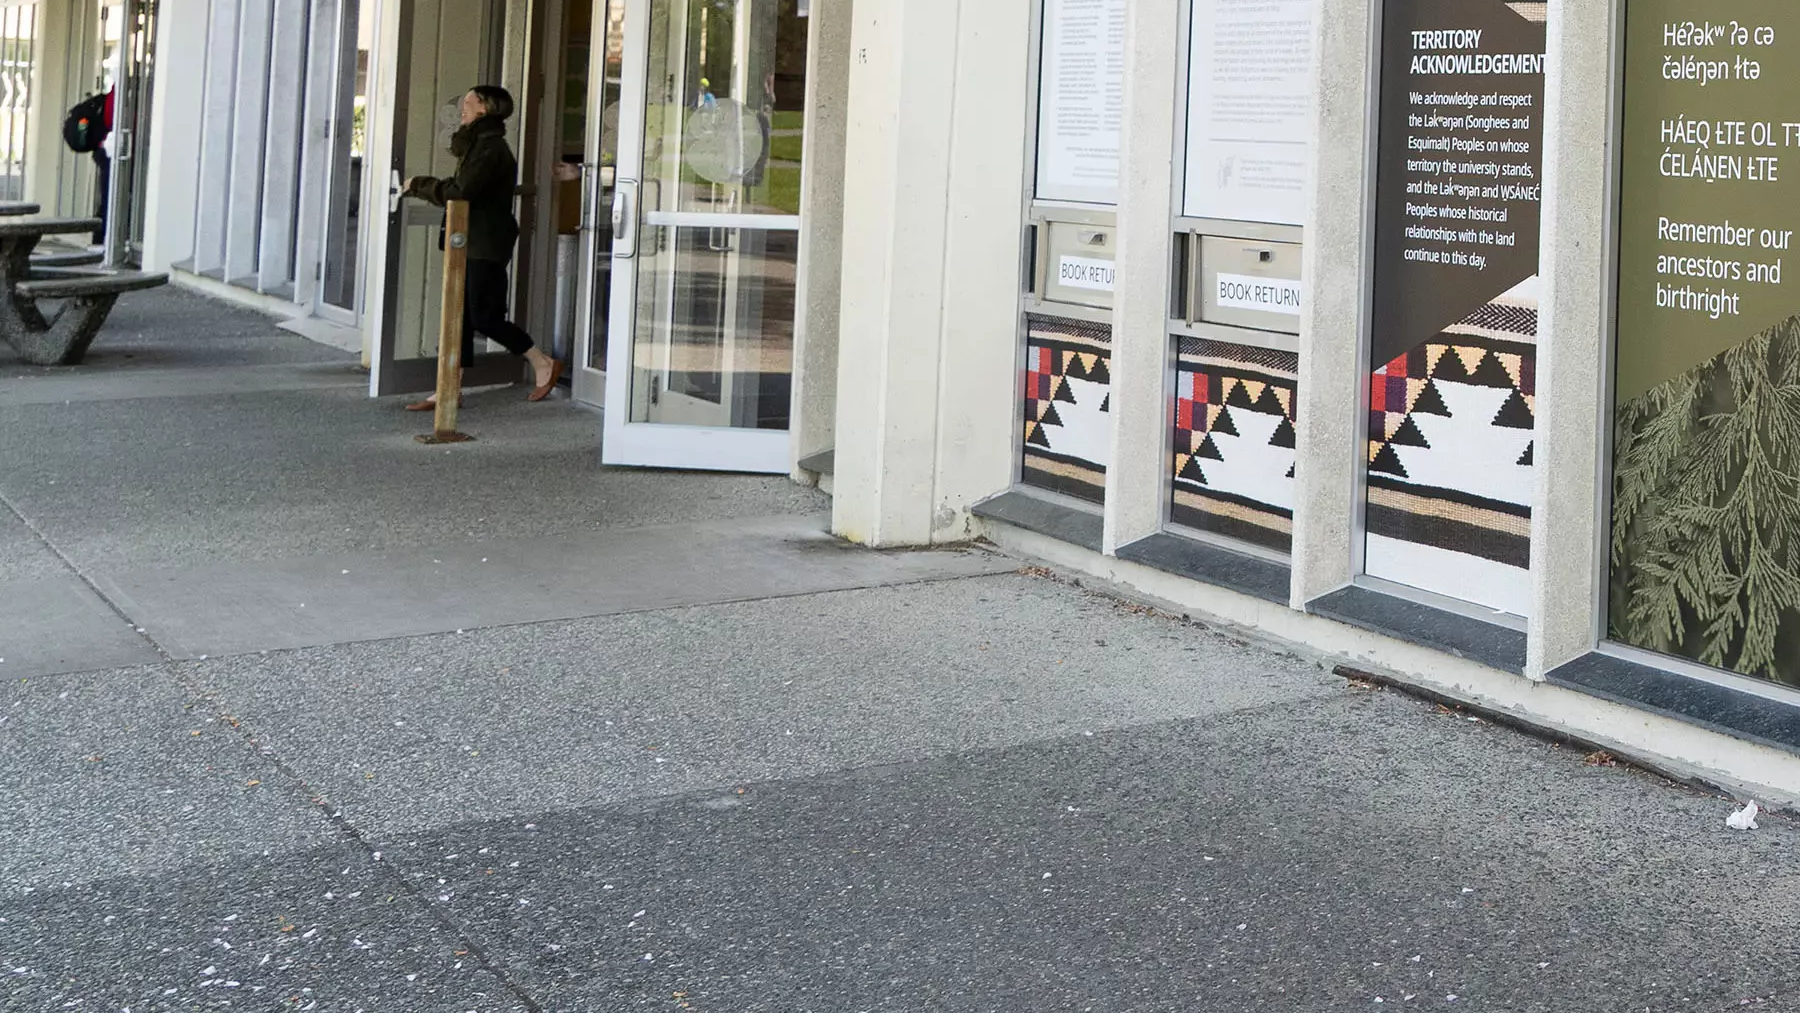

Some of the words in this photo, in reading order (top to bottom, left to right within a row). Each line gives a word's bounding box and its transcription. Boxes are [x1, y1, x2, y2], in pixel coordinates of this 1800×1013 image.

[1411, 28, 1482, 50] TERRITORY
[1410, 54, 1546, 74] ACKNOWLEDGEMENT
[1409, 91, 1423, 105] We
[1423, 91, 1479, 110] acknowledge
[1479, 91, 1498, 106] and
[1498, 93, 1533, 110] respect
[1408, 112, 1423, 127] the
[1465, 114, 1511, 133] (Songhees
[1511, 115, 1530, 130] and
[1661, 113, 1711, 149] HÁEQ
[1751, 121, 1777, 147] OL
[1408, 135, 1451, 153] Esquimalt)
[1451, 136, 1485, 155] Peoples
[1486, 140, 1499, 152] on
[1499, 138, 1530, 153] whose
[1407, 158, 1442, 177] territory
[1442, 158, 1457, 174] the
[1458, 159, 1501, 179] university
[1501, 162, 1534, 179] stands,
[1406, 179, 1423, 194] and
[1423, 180, 1439, 195] the
[1481, 183, 1499, 199] and
[1405, 201, 1438, 220] Peoples
[1438, 204, 1467, 220] whose
[1468, 205, 1508, 222] historical
[1405, 224, 1457, 245] relationships
[1458, 228, 1478, 243] with
[1478, 229, 1494, 245] the
[1495, 230, 1515, 247] land
[1658, 216, 1756, 247] Remember
[1759, 229, 1793, 250] our
[1404, 247, 1440, 263] continue
[1440, 251, 1451, 264] to
[1451, 250, 1468, 266] this
[1468, 251, 1487, 271] day.
[1656, 255, 1741, 280] ancestors
[1745, 258, 1781, 284] and
[1656, 282, 1740, 320] birthright
